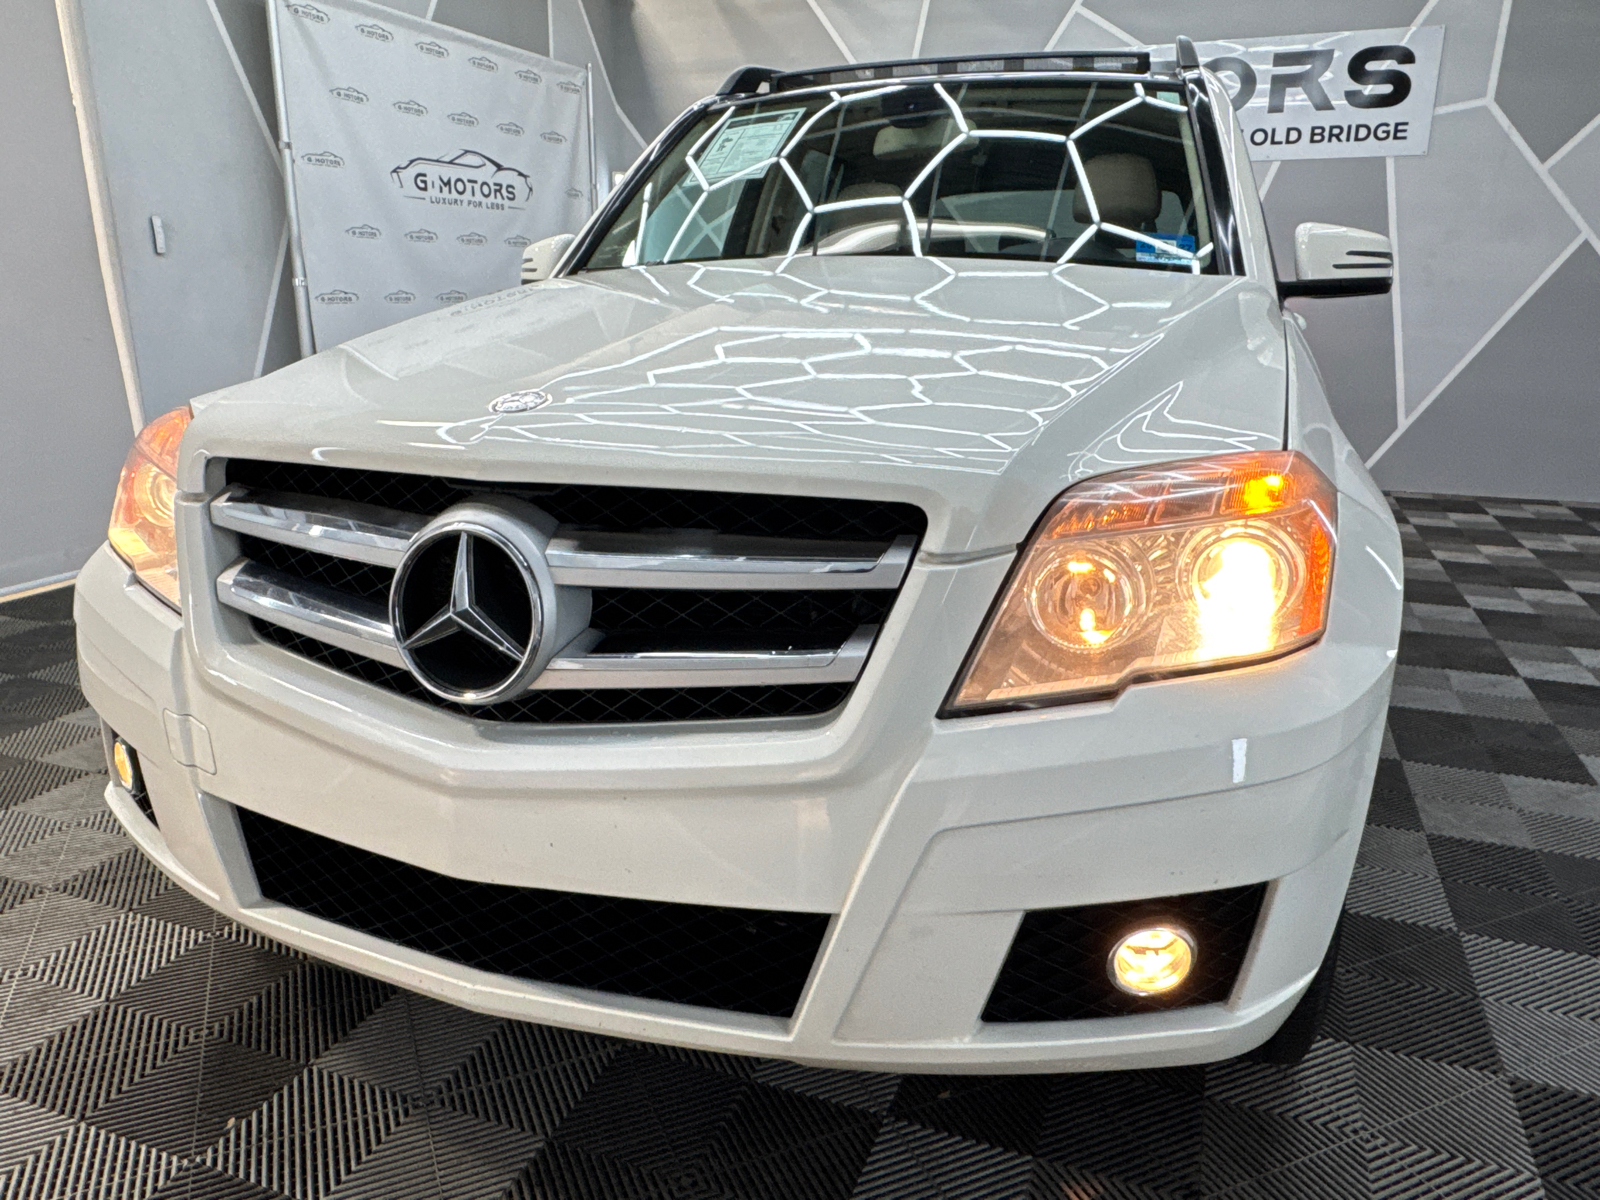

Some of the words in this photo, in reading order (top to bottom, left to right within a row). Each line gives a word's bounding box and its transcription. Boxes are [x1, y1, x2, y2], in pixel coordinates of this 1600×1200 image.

[1150, 45, 1416, 114] ORS
[1250, 126, 1302, 146] OLD
[1309, 122, 1409, 144] BRIDGE
[314, 158, 341, 166] MOTORS
[414, 172, 428, 192] G
[438, 174, 516, 201] MOTORS
[430, 196, 464, 206] LUXURY
[467, 200, 483, 209] FOR
[486, 202, 504, 210] LESS
